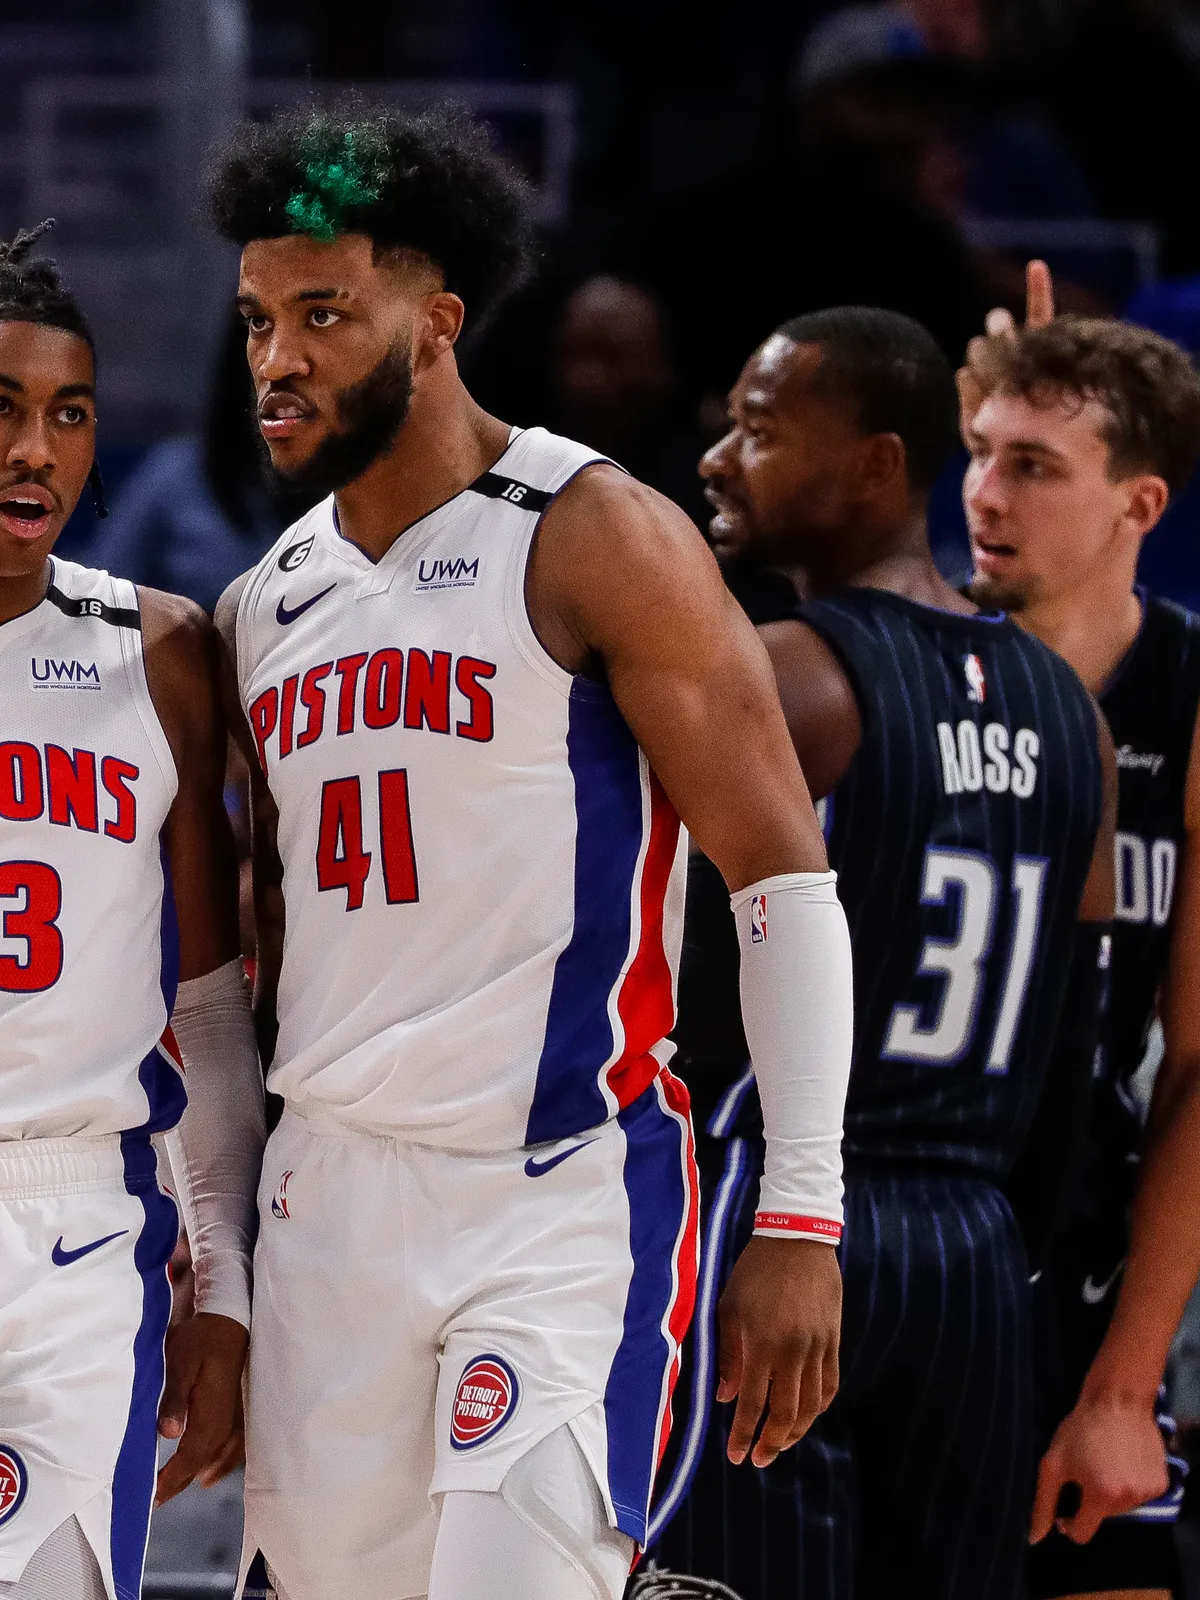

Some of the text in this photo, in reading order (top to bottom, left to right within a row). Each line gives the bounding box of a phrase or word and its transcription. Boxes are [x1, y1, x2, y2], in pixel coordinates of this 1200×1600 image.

[501, 483, 528, 502] 16
[418, 556, 480, 582] UWM
[79, 600, 102, 615] 16
[31, 657, 101, 683] UWM
[249, 647, 498, 781] PISTONS
[936, 719, 1040, 799] ROSS
[315, 768, 420, 913] 41
[878, 843, 1051, 1076] 31
[461, 1384, 502, 1406] DETROIT
[456, 1400, 496, 1420] PISTONS
